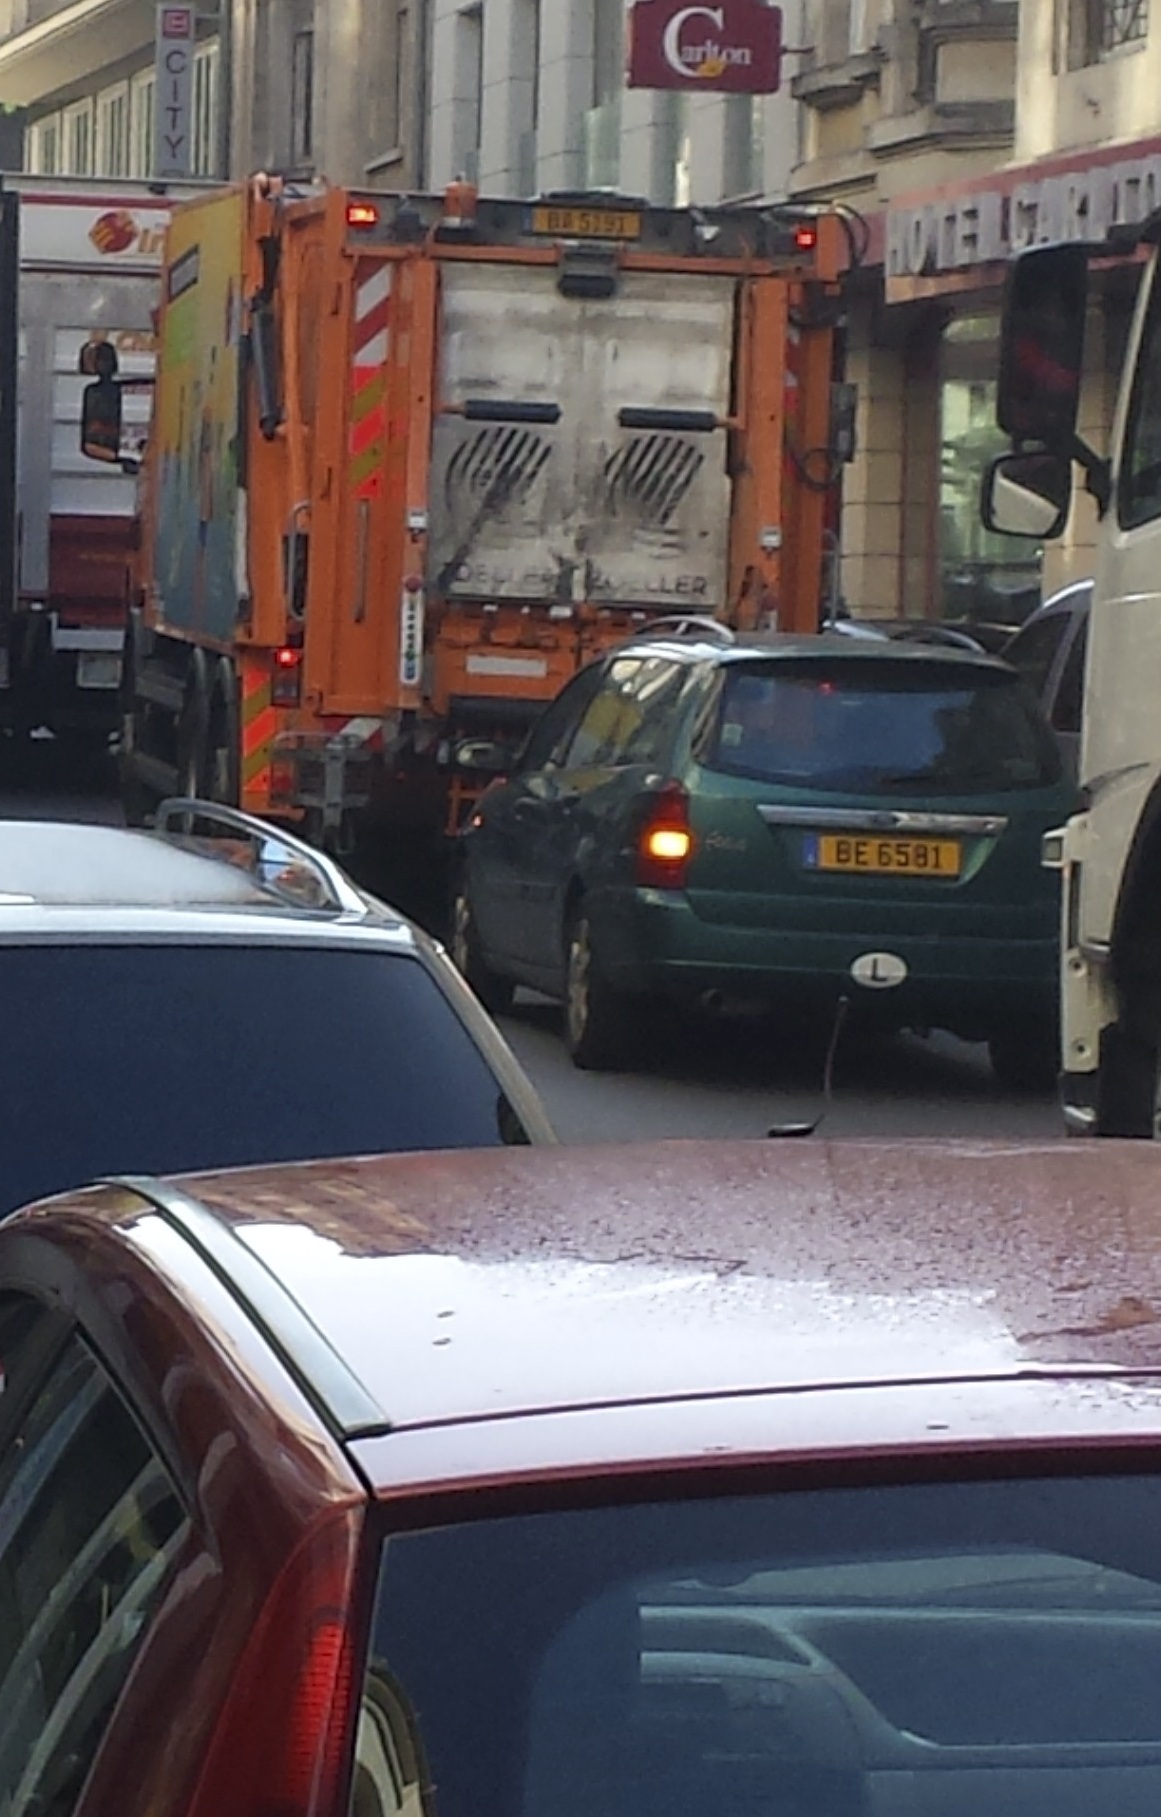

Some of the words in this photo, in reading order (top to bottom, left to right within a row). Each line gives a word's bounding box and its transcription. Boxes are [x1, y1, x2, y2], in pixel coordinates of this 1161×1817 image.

[663, 6, 752, 78] Carlton
[164, 50, 186, 160] CITY
[886, 191, 1008, 275] HOTEL
[835, 839, 870, 868] BE
[877, 842, 942, 872] 6581
[870, 958, 887, 981] L
